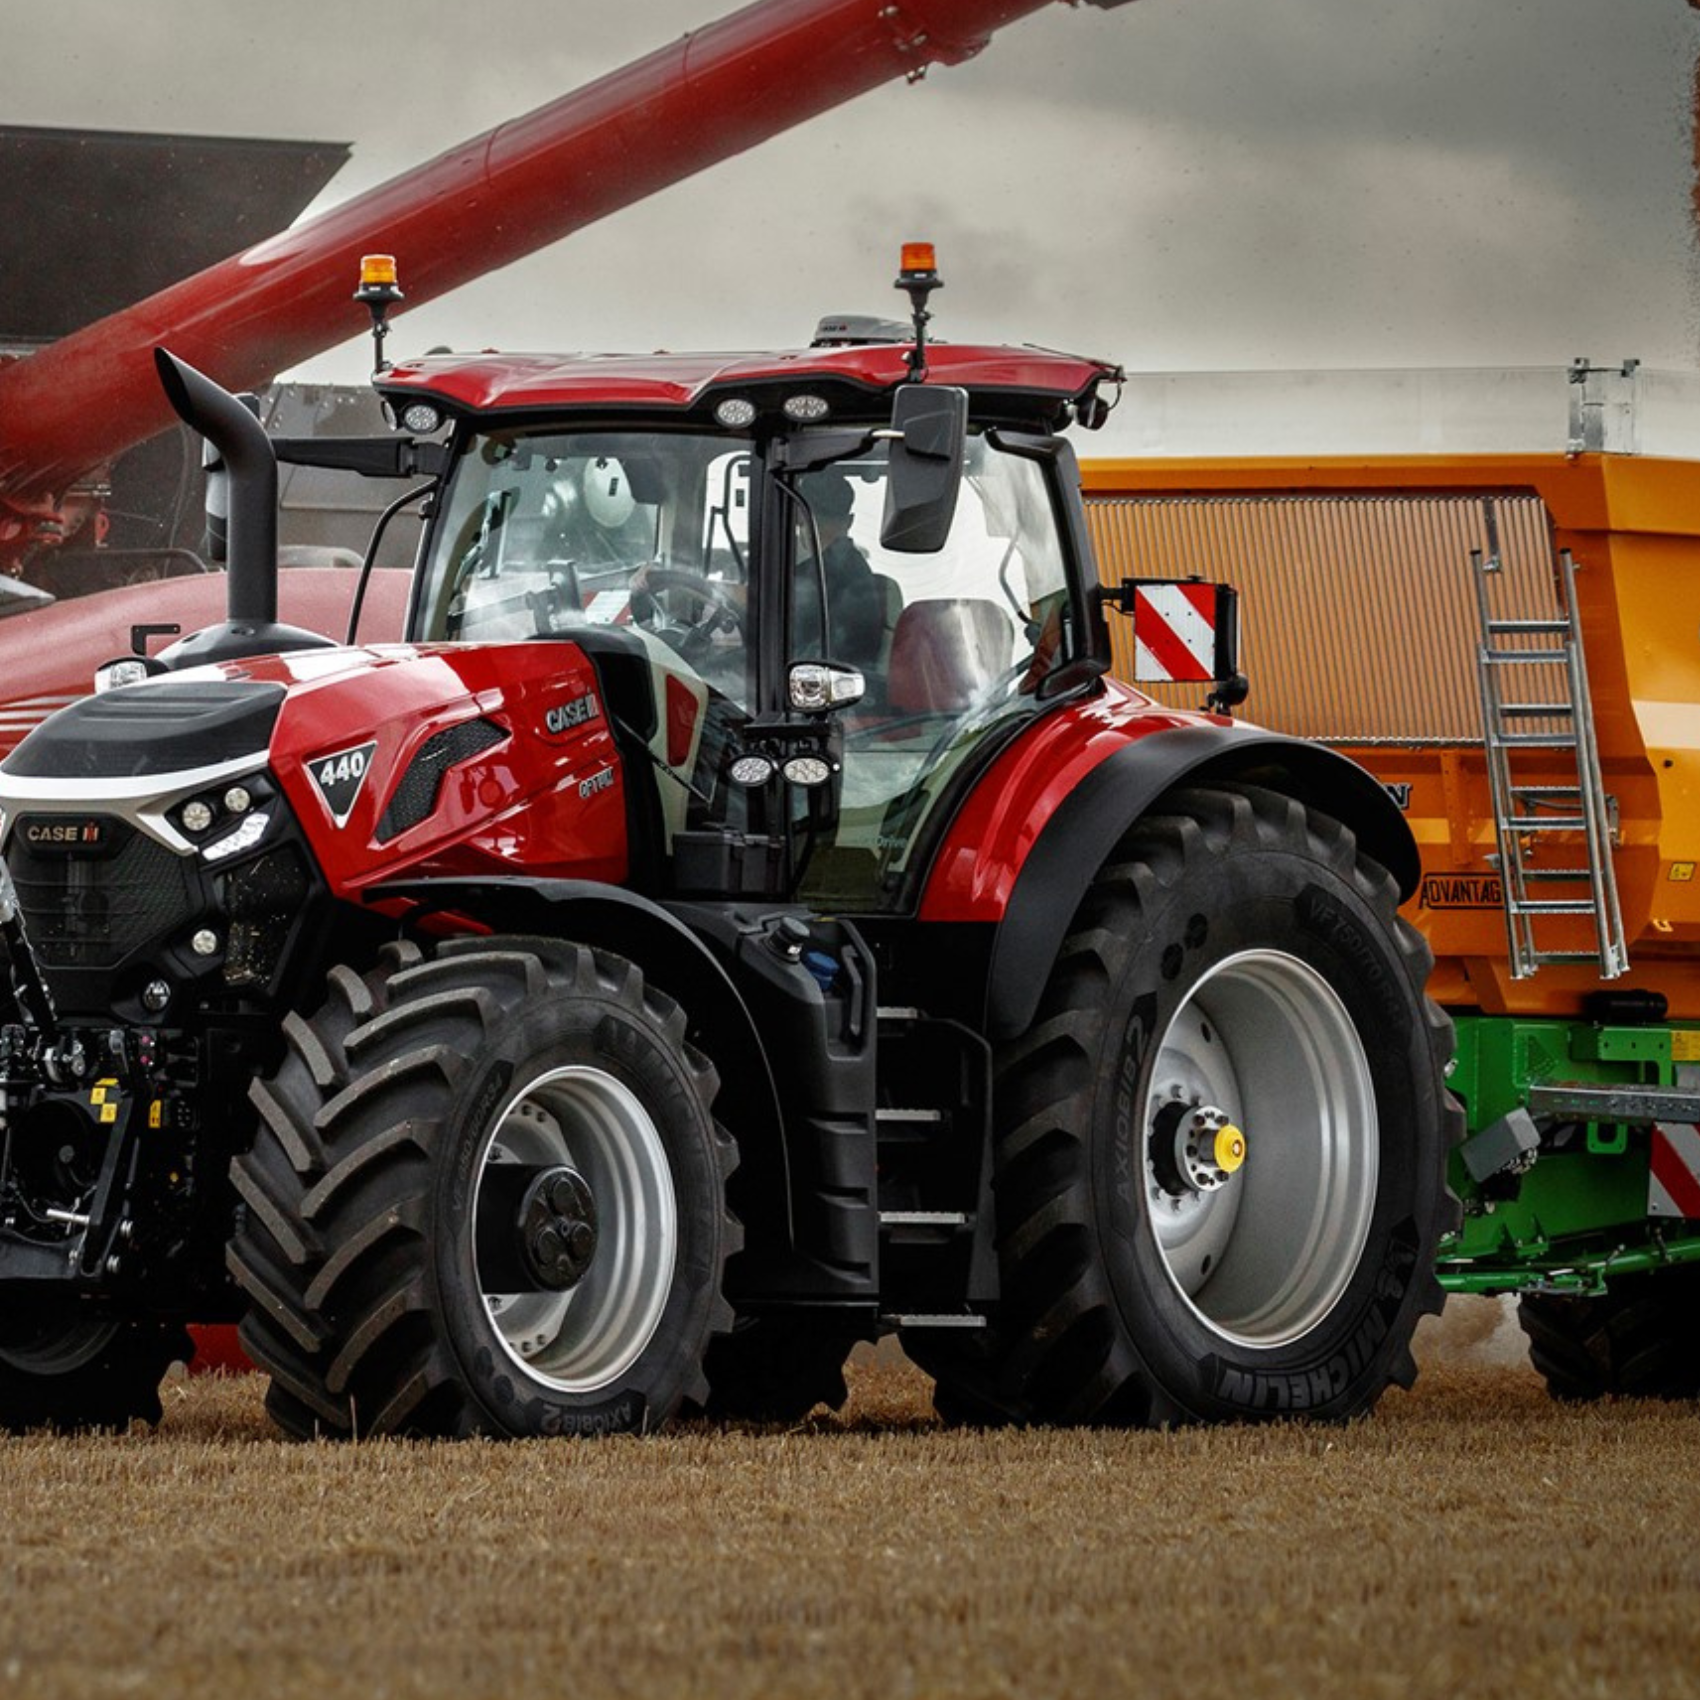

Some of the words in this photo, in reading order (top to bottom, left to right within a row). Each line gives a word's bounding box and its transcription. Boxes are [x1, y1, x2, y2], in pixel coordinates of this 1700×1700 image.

[546, 697, 586, 733] CASE
[320, 751, 365, 786] 440
[27, 825, 78, 841] CASE
[1418, 879, 1501, 910] ADVANTAG
[1217, 1304, 1387, 1410] MICHELIN
